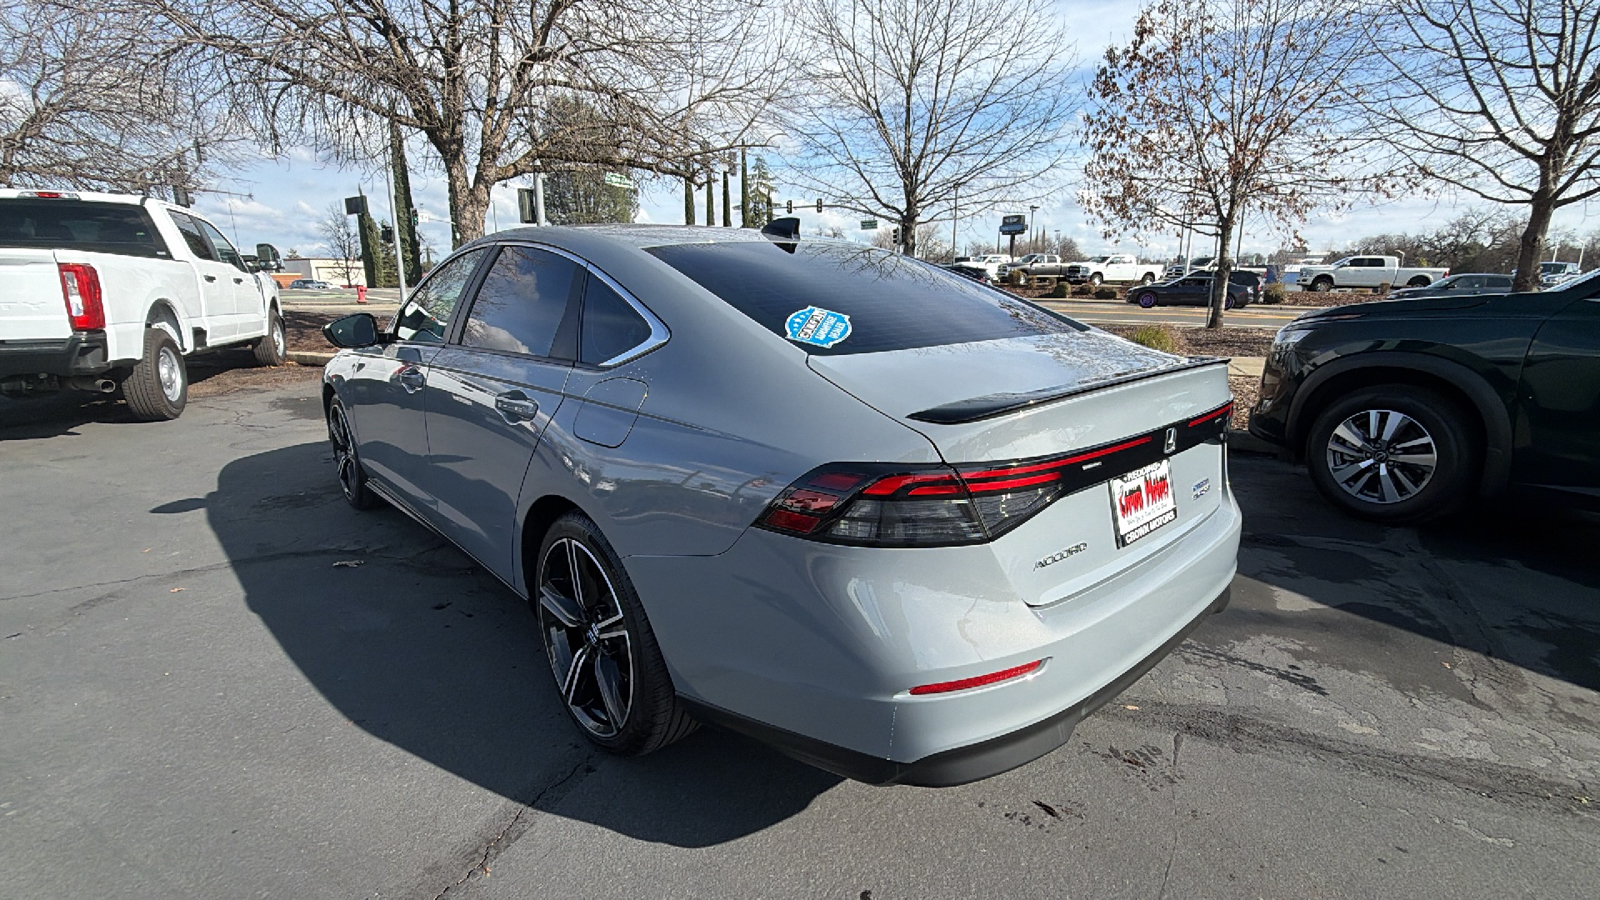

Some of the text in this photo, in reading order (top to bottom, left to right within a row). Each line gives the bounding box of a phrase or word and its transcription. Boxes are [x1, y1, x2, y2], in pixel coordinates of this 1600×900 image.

[1126, 463, 1160, 481] REDDING
[1118, 484, 1144, 519] Crown
[1143, 471, 1170, 508] Motors
[1125, 523, 1150, 544] CROWN
[1149, 511, 1175, 532] MOTORS
[1033, 542, 1087, 572] ACCORD
